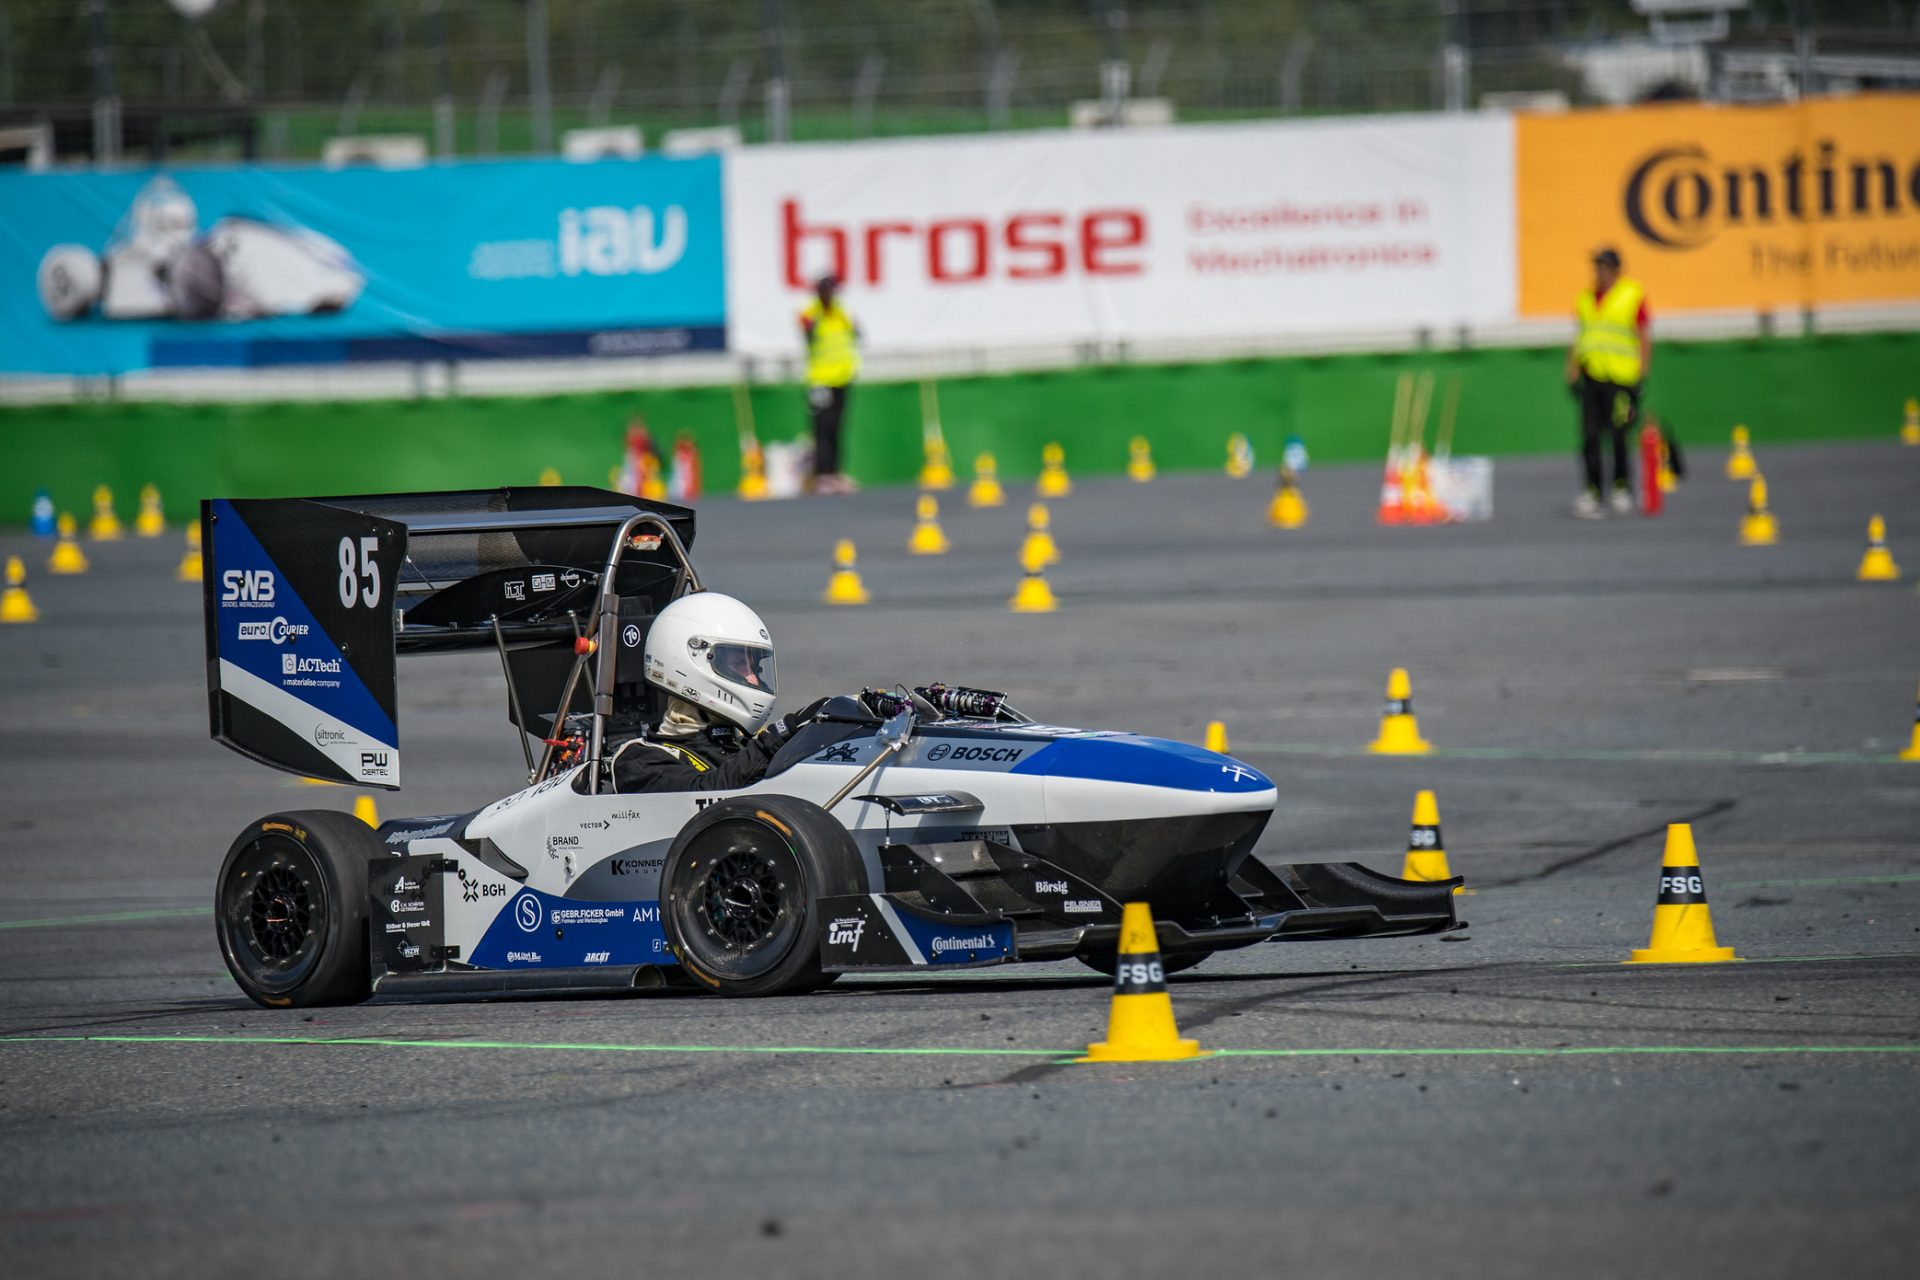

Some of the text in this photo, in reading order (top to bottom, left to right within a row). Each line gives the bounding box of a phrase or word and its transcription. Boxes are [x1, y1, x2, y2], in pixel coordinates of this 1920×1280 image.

[559, 204, 687, 277] iav
[782, 195, 1148, 288] brose
[339, 536, 381, 609] 85
[222, 570, 275, 601] SWB
[317, 680, 341, 688] company
[317, 728, 345, 740] siltronic
[361, 753, 388, 767] PW
[949, 746, 1023, 763] BOSCH
[611, 810, 640, 821] millfax
[552, 836, 579, 846] BRAND
[482, 884, 506, 896] BGH
[1035, 881, 1068, 894] Börsig
[1660, 875, 1703, 895] FSG
[605, 909, 624, 917] GmbH
[632, 907, 653, 922] AM
[829, 920, 865, 952] imf
[931, 935, 986, 954] Continental
[1118, 962, 1164, 985] FSG
